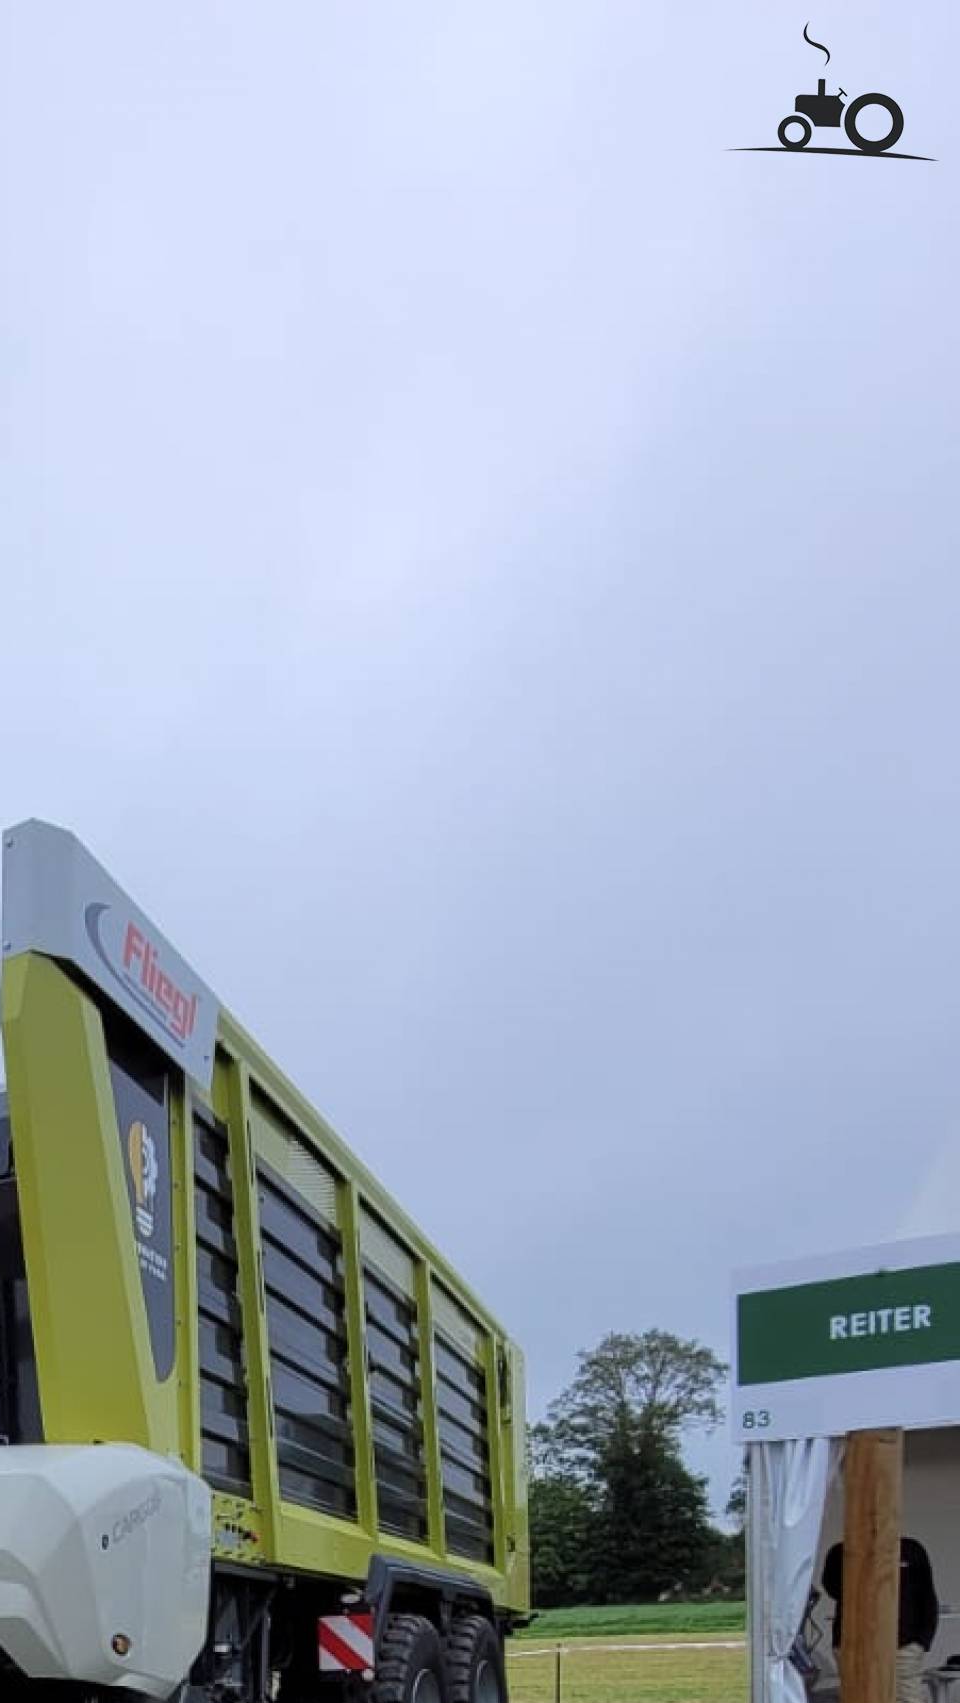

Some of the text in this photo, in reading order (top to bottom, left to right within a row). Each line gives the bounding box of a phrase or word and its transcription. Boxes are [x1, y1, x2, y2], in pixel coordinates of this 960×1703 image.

[123, 920, 197, 1039] Fliegl
[829, 1305, 931, 1340] REITER
[742, 1410, 771, 1429] 83
